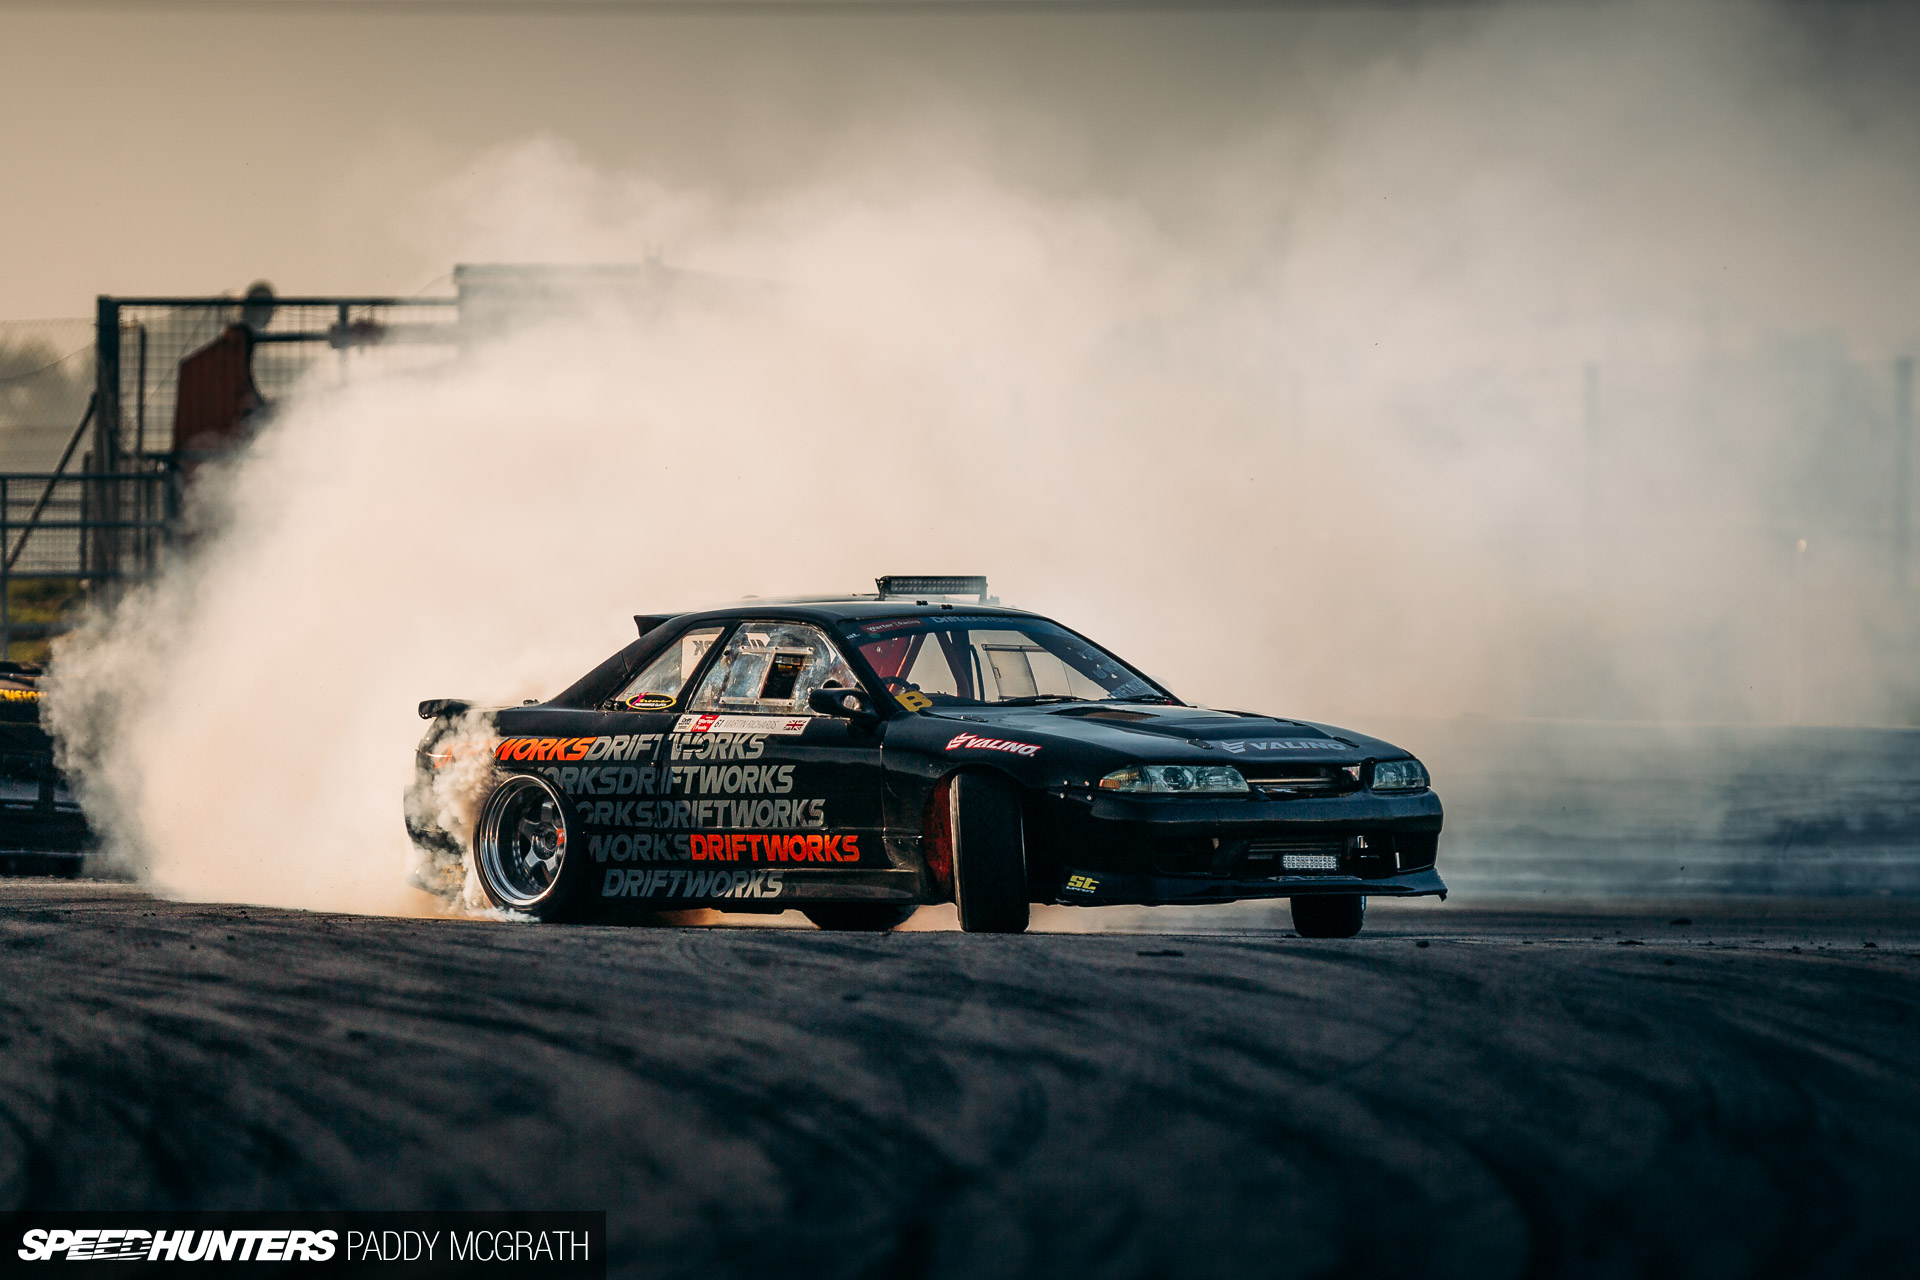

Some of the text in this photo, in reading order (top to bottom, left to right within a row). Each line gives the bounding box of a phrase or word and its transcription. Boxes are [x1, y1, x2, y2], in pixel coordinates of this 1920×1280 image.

[964, 737, 1042, 756] VALINO
[1250, 741, 1347, 751] VALINO
[690, 834, 860, 862] DRIFTWORKS
[602, 869, 784, 897] DRIFTWORKS
